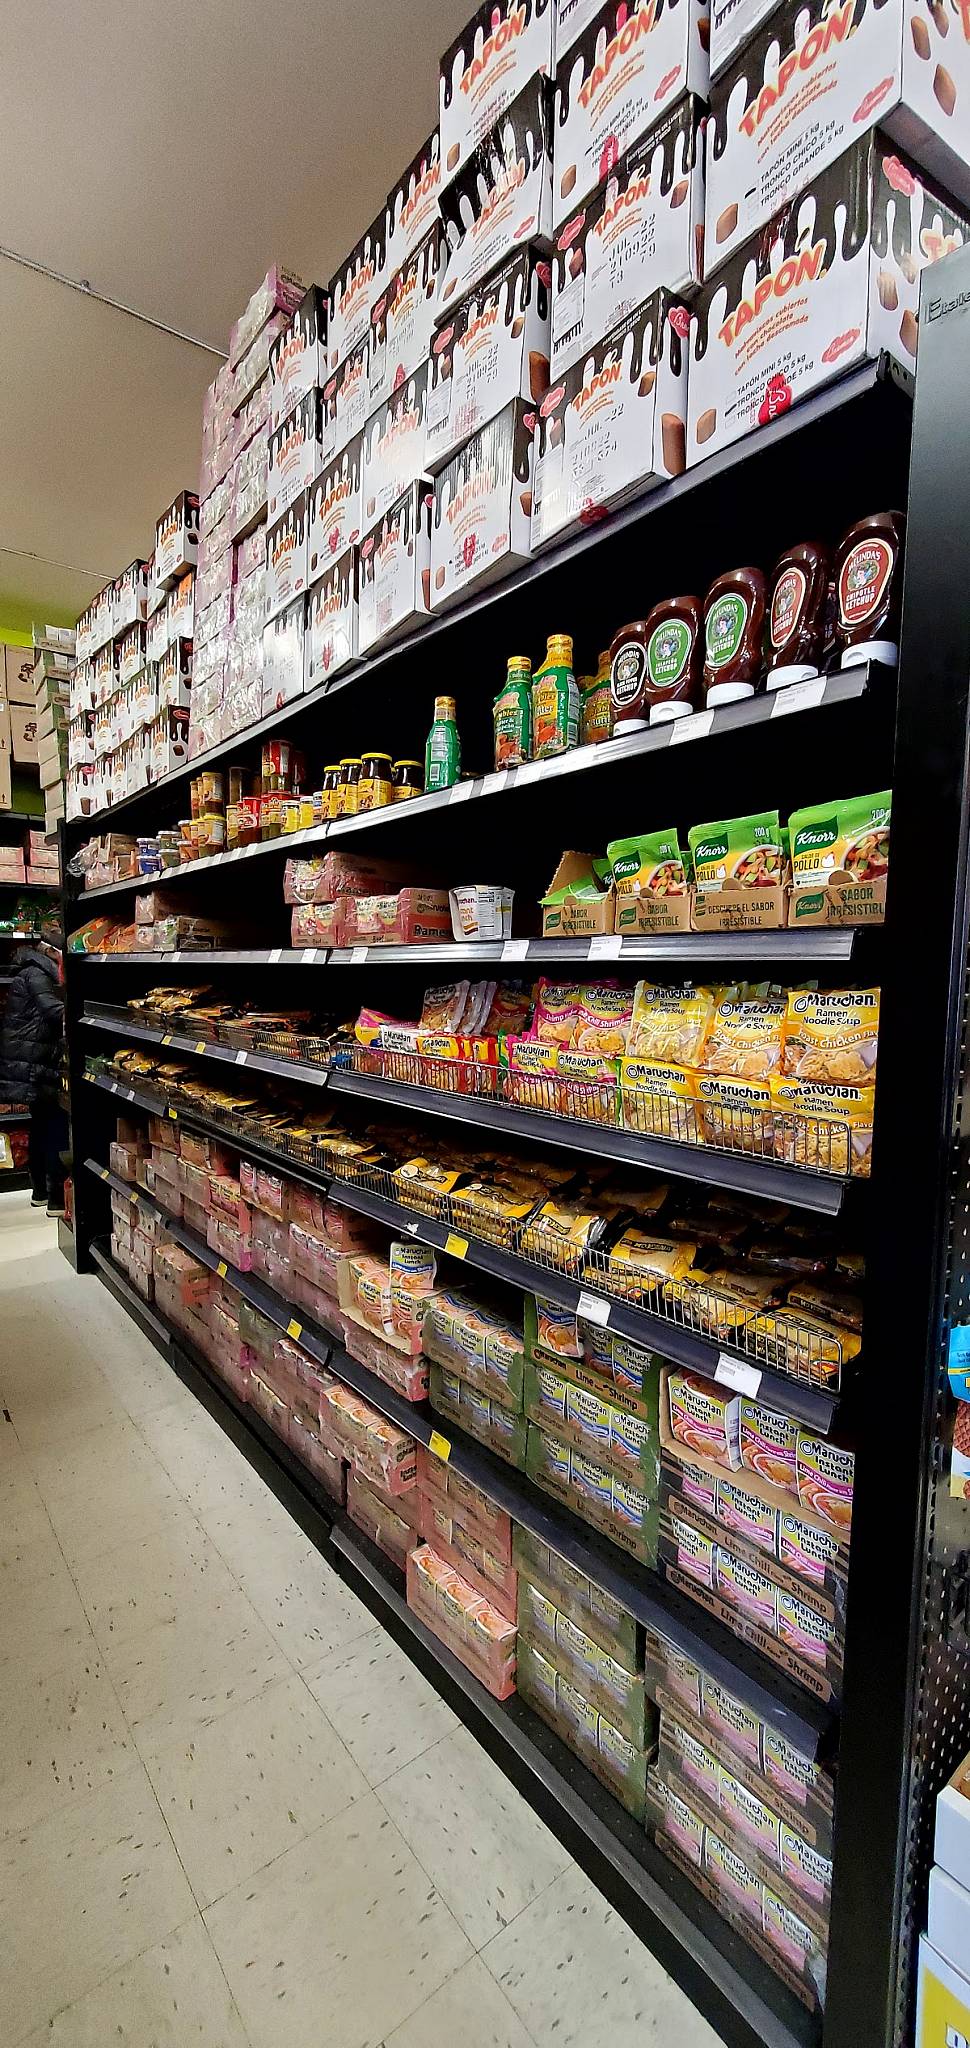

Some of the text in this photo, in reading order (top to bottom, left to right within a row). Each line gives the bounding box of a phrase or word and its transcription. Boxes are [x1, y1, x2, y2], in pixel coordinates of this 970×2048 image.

[786, 136, 803, 158] MINI
[810, 122, 820, 135] kg
[760, 119, 836, 195] TRONCO CHICO kg
[760, 175, 792, 207] TRONCO
[792, 143, 826, 176] GRANDE
[834, 124, 844, 137] kg
[760, 362, 777, 377] MINI
[783, 351, 793, 361] kg
[736, 382, 766, 407] TRONCO
[797, 353, 807, 365] kg
[736, 360, 814, 419] TRONCO kg
[844, 593, 876, 610] KETCHUP
[846, 585, 877, 601] CHIPOTLE
[797, 830, 837, 845] Knorr
[695, 844, 727, 858] Knorr
[614, 861, 640, 875] Knorr
[794, 858, 819, 872] POLLO
[696, 869, 716, 882] POLLO
[842, 887, 874, 901] SABOR
[751, 901, 775, 912] SABOR
[654, 989, 697, 1000] Maruchan
[659, 1000, 680, 1008] Ramen
[803, 1015, 837, 1026] Noodle
[816, 1008, 849, 1018] Ramen
[819, 1030, 862, 1049] Chicken
[637, 1064, 686, 1084] Maruchan
[645, 1077, 668, 1087] Ramen
[635, 1082, 659, 1093] Noodle
[710, 1081, 770, 1101] Maruchan
[823, 1106, 851, 1116] Soup
[575, 1370, 638, 1411] Lime Shrimp
[682, 1387, 722, 1417] Maruchan
[683, 1399, 712, 1420] Instant
[686, 1406, 709, 1424] Lunch
[755, 1419, 790, 1441] Instant
[759, 1429, 786, 1447] Lunch
[799, 1463, 814, 1478] Lime
[815, 1455, 853, 1477] Instant
[818, 1465, 849, 1483] Lunch
[731, 1494, 761, 1518] Instant
[734, 1504, 758, 1523] Lunch
[680, 1502, 719, 1536] Maruchan
[671, 1518, 708, 1552] Maruchan
[796, 1532, 833, 1558] Instant
[728, 1556, 773, 1592] Maruchan
[731, 1569, 761, 1594] Instant
[678, 1574, 716, 1607] Maruchan
[734, 1577, 758, 1597] Lunch
[790, 1581, 828, 1613] Shrimp
[793, 1612, 830, 1637] Instant
[786, 1657, 824, 1694] Shrimp
